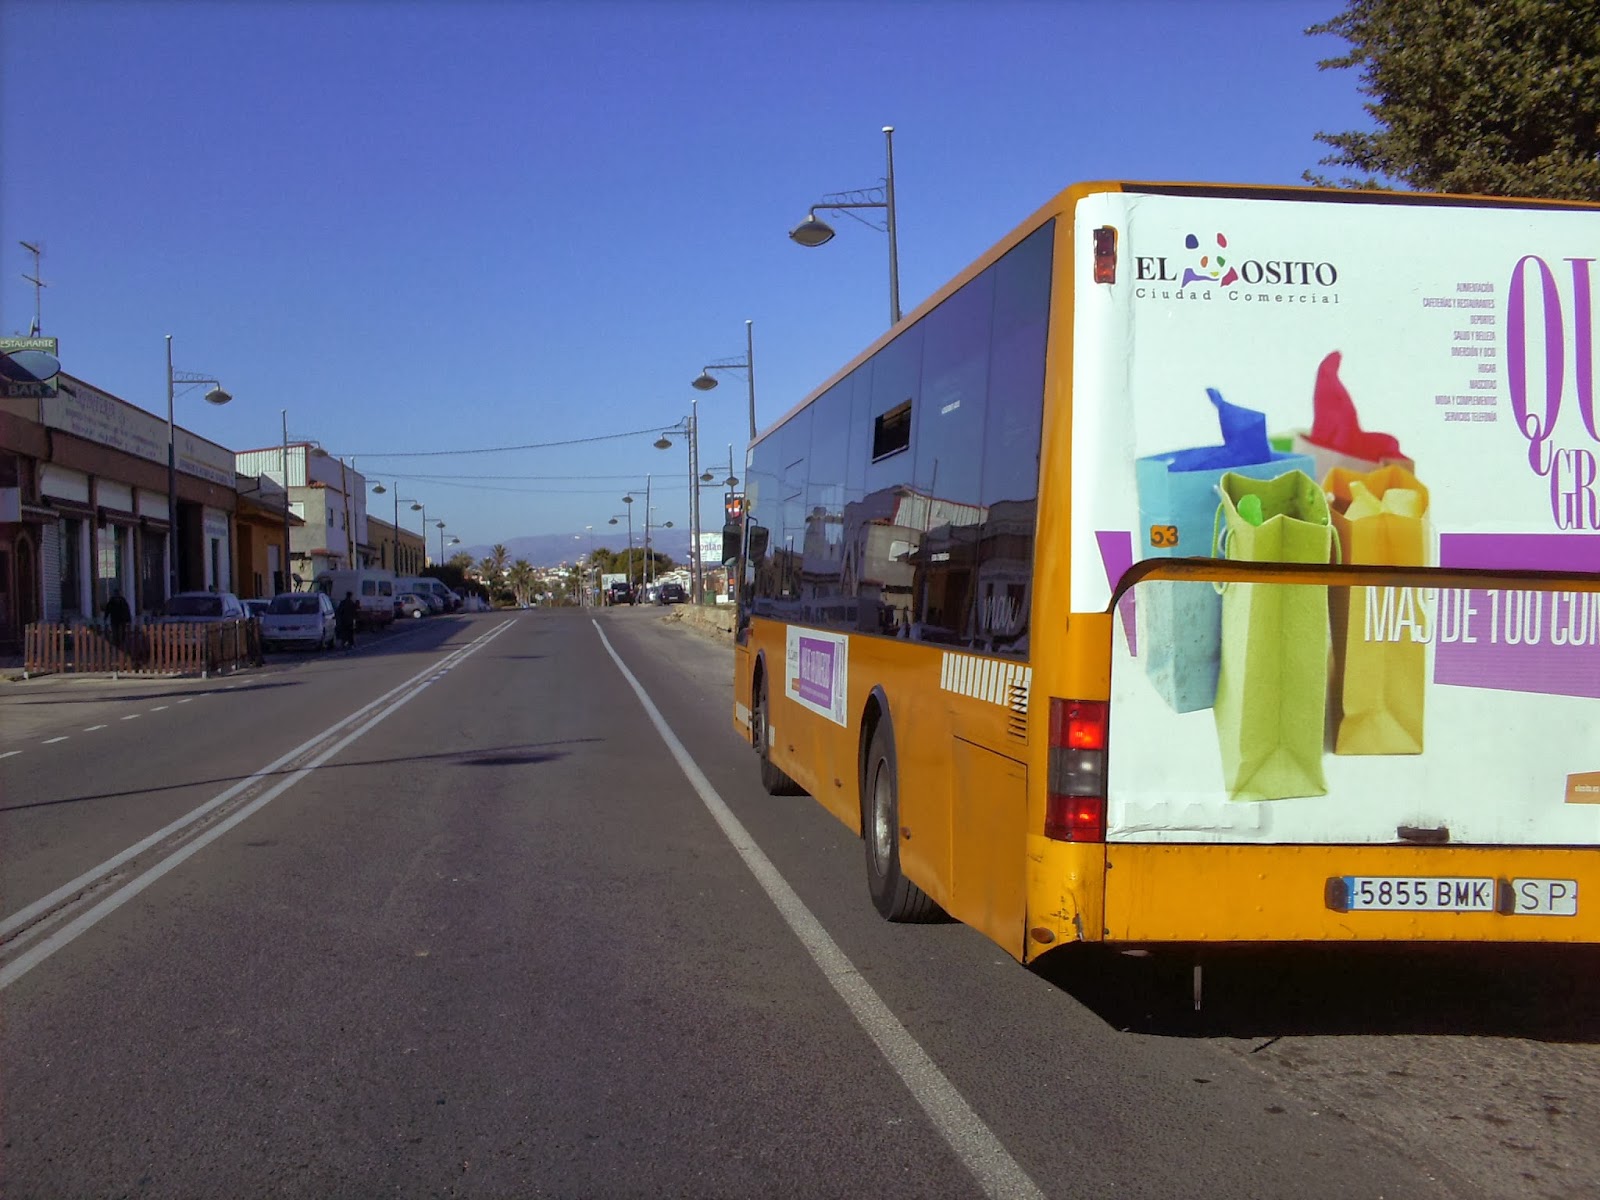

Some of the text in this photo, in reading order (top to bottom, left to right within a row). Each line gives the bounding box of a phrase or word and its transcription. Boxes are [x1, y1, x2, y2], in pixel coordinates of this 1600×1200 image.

[1135, 256, 1338, 286] EL OSITO
[1136, 287, 1339, 304] Ciudad Comercial
[1475, 331, 1495, 341] BELLEZA
[1478, 364, 1496, 373] HOGAR
[8, 384, 42, 397] BAR
[1469, 380, 1497, 389] MASCOTAS
[1441, 588, 1478, 644] DE
[1487, 589, 1542, 646] 100
[1360, 881, 1428, 906] 5855
[1437, 881, 1488, 907] BMK
